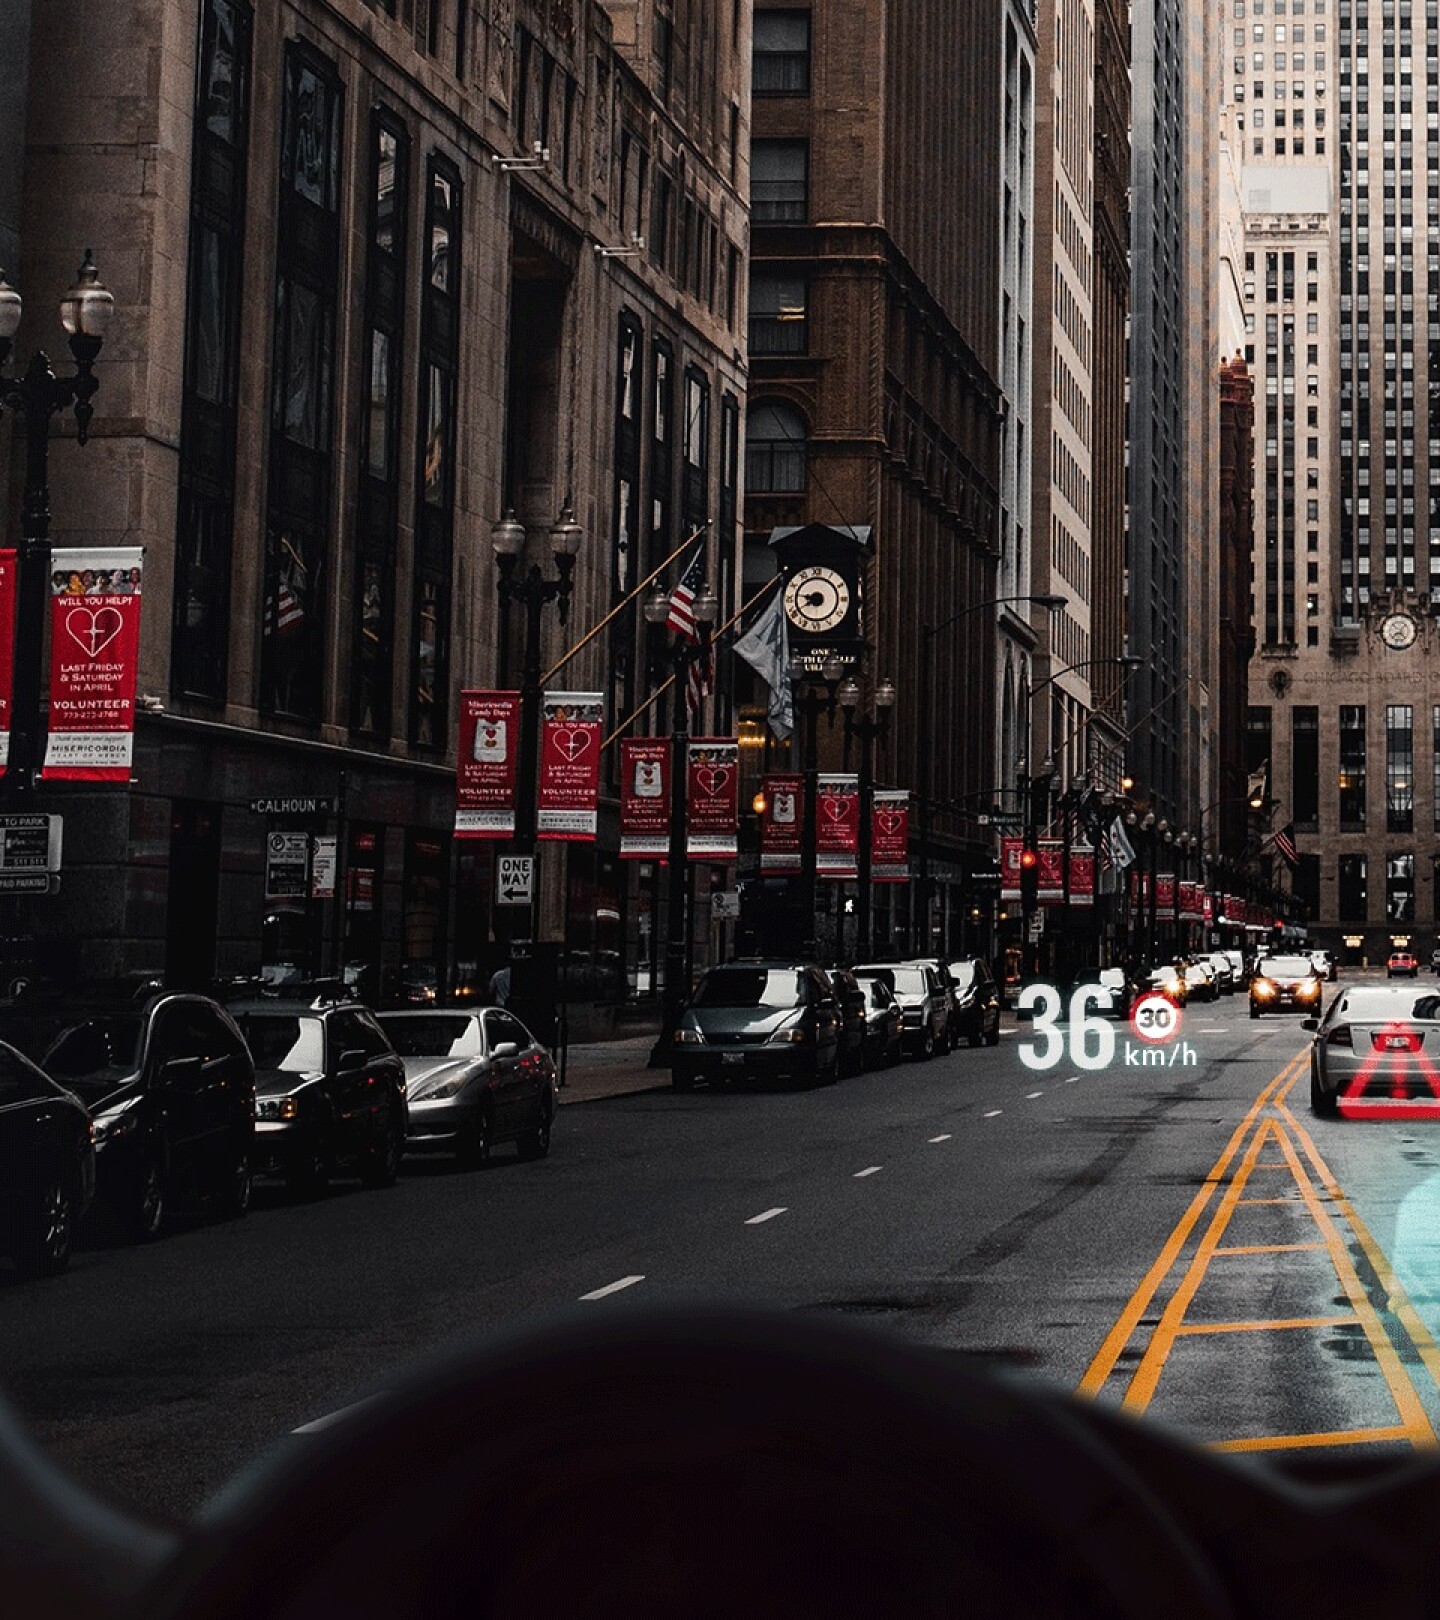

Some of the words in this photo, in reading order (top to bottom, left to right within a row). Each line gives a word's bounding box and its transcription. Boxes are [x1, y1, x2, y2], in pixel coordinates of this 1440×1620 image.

[58, 597, 82, 606] WILL
[84, 597, 103, 606] YOU
[105, 597, 132, 606] HELP?
[60, 664, 85, 672] LAST
[88, 664, 124, 672] FRIDAY
[60, 673, 70, 682] &
[72, 673, 123, 682] SATURDAY
[70, 683, 80, 691] IN
[83, 683, 114, 691] APRIL
[53, 700, 130, 709] VOLUNTEER
[257, 799, 316, 812] CALHOUN
[502, 860, 529, 871] ONE
[501, 874, 530, 885] WAY
